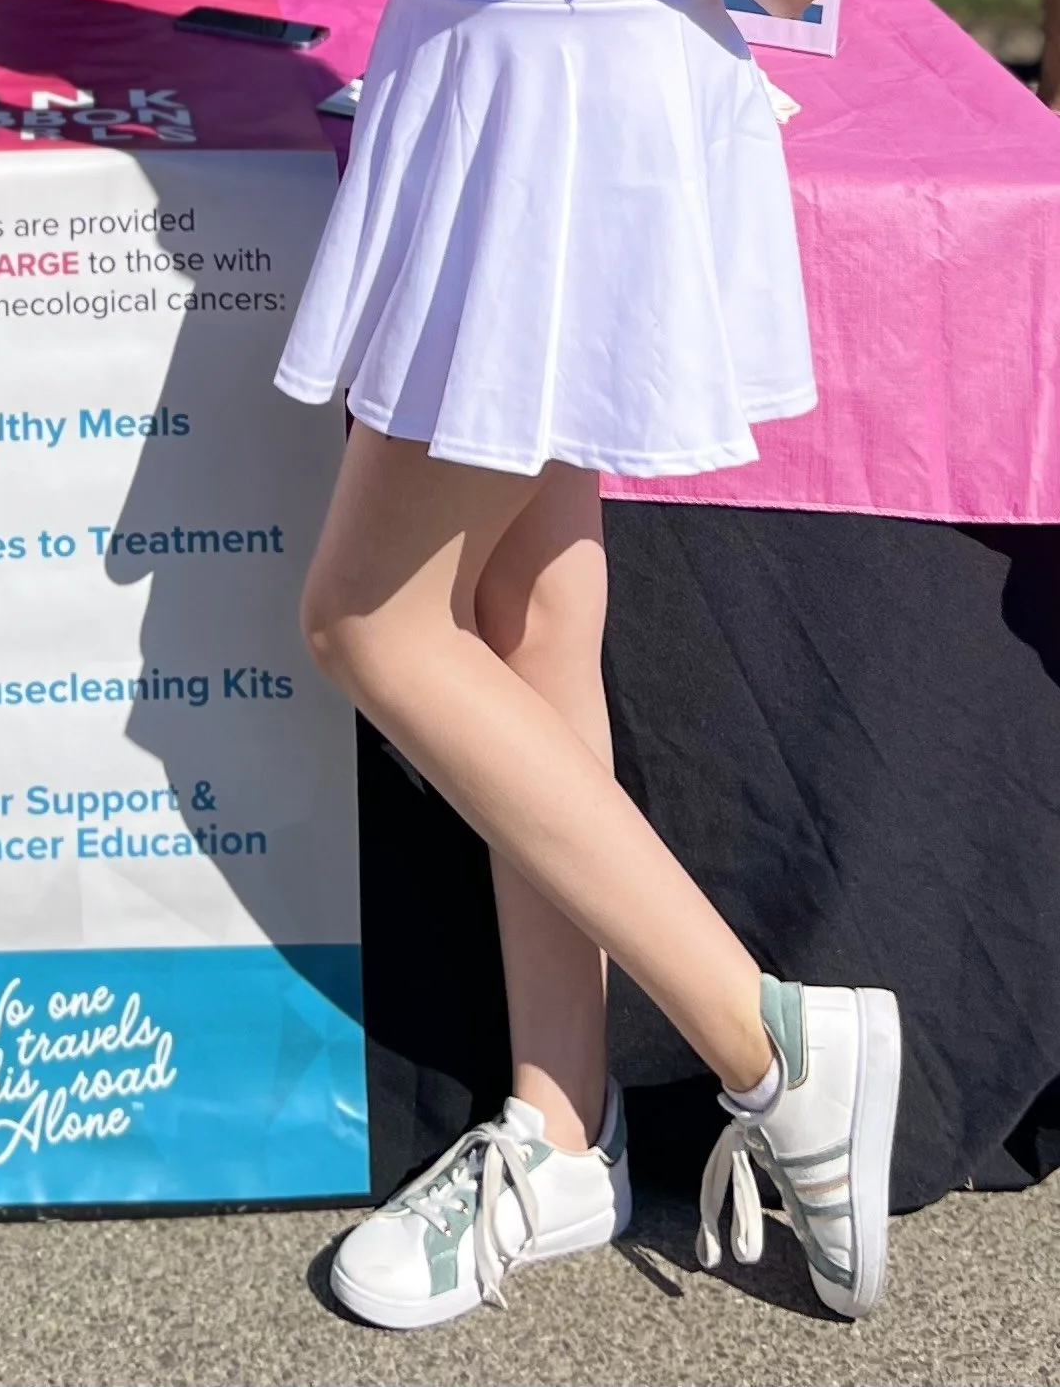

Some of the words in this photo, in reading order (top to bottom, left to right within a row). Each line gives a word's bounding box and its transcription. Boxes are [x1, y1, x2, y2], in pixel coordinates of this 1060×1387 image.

[14, 216, 59, 237] are
[70, 208, 195, 241] provided
[88, 254, 116, 275] to
[125, 249, 204, 274] those
[213, 247, 272, 272] with
[166, 291, 286, 313] cancers:
[78, 406, 191, 441] Meals
[39, 530, 77, 558] to
[87, 524, 285, 556] Treatment
[222, 667, 294, 701] Kits
[25, 782, 180, 822] Support
[191, 780, 218, 812] &
[76, 824, 267, 860] Education
[47, 985, 116, 1021] one
[16, 991, 161, 1067] travels
[69, 1030, 178, 1103] road
